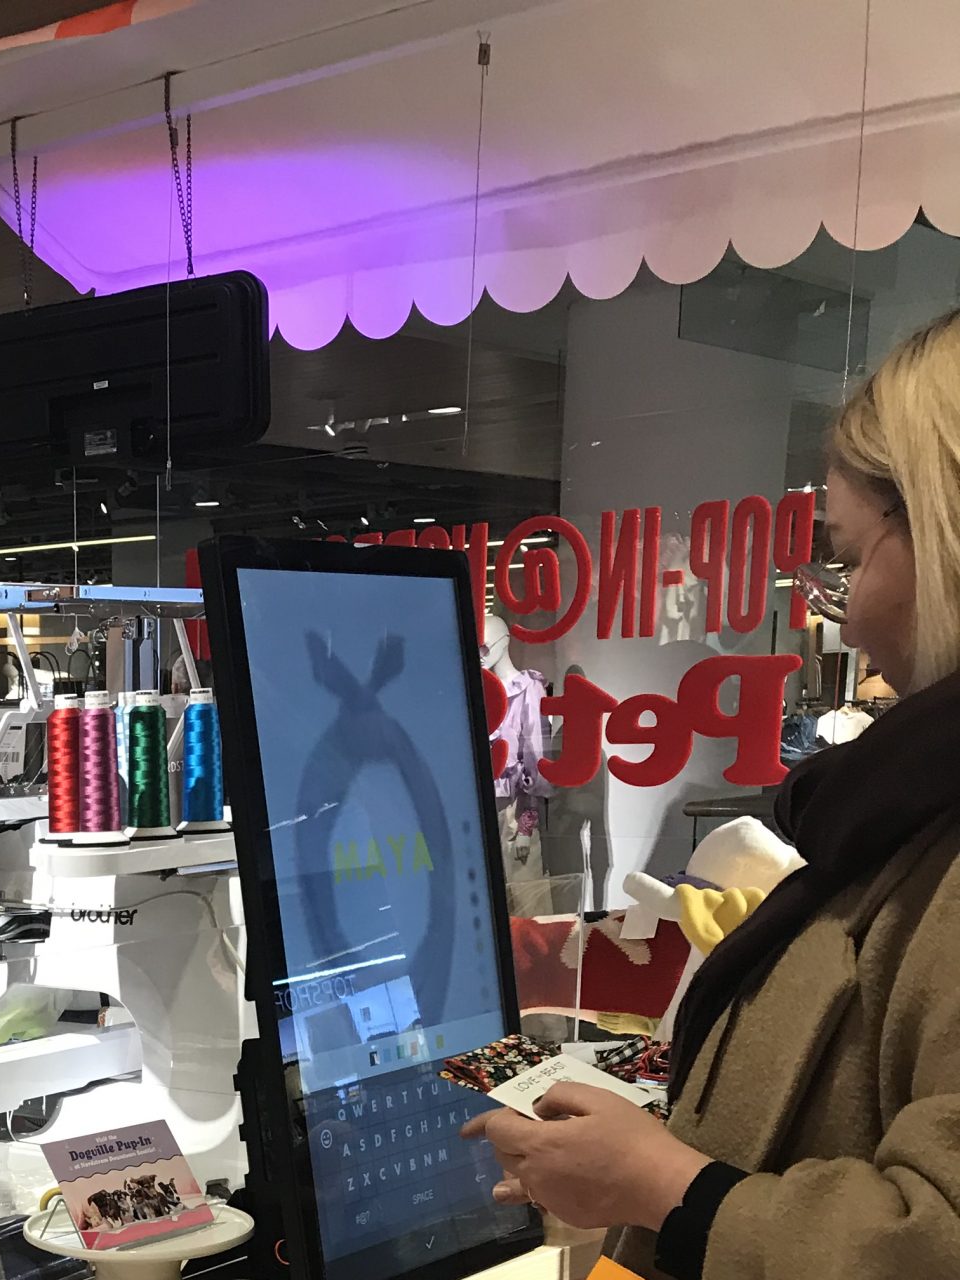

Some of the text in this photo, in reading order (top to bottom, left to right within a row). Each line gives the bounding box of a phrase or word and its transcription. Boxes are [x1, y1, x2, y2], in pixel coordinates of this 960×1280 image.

[334, 832, 434, 884] MAYA
[68, 1135, 152, 1161] Dogville Pup-In
